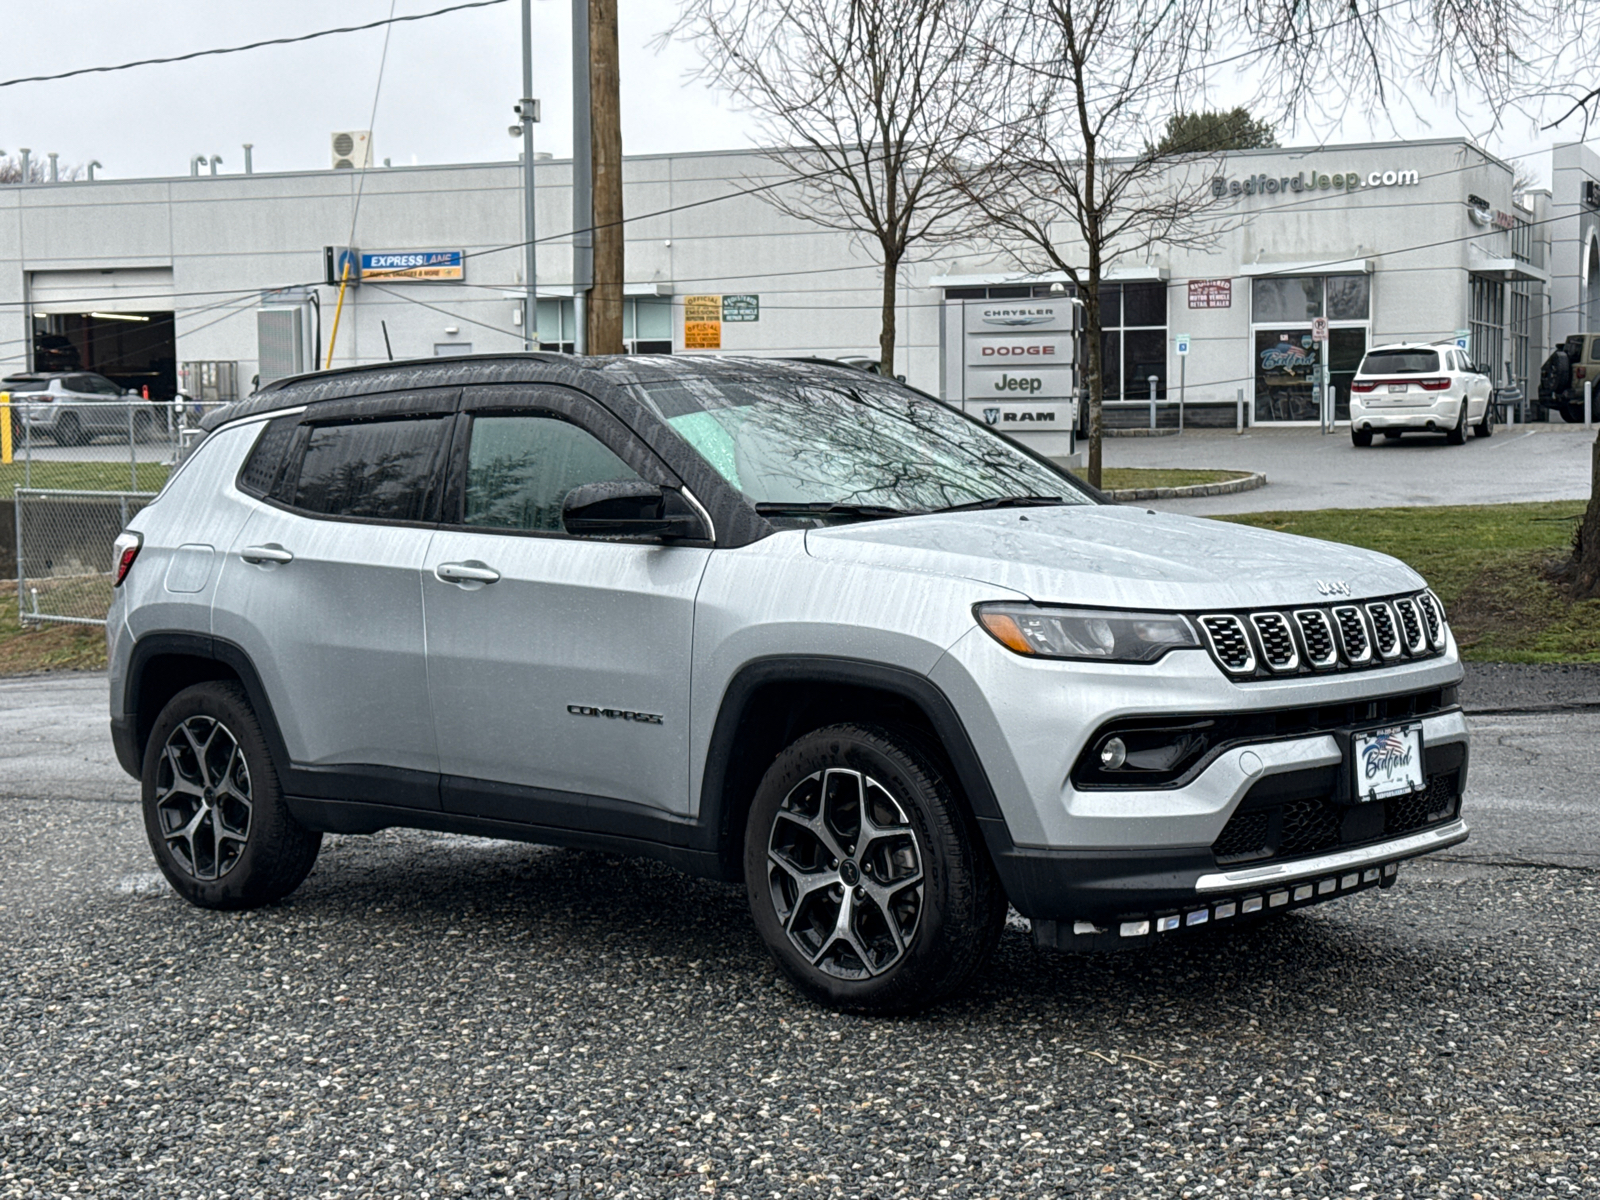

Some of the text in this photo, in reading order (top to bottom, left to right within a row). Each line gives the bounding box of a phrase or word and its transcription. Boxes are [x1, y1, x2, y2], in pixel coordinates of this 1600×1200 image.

[1211, 169, 1419, 196] BedfordJeep.com
[687, 295, 718, 305] OFFICIAL
[984, 309, 1053, 317] CHRYSLER
[687, 323, 718, 332] OFFICIAL
[982, 346, 1055, 356] DODGE
[1260, 348, 1316, 371] Bedford
[994, 374, 1042, 394] Jeep
[1003, 412, 1055, 422] RAM
[1317, 580, 1351, 597] Jeep
[567, 705, 664, 725] COMPASS
[1362, 743, 1412, 780] Bedford
